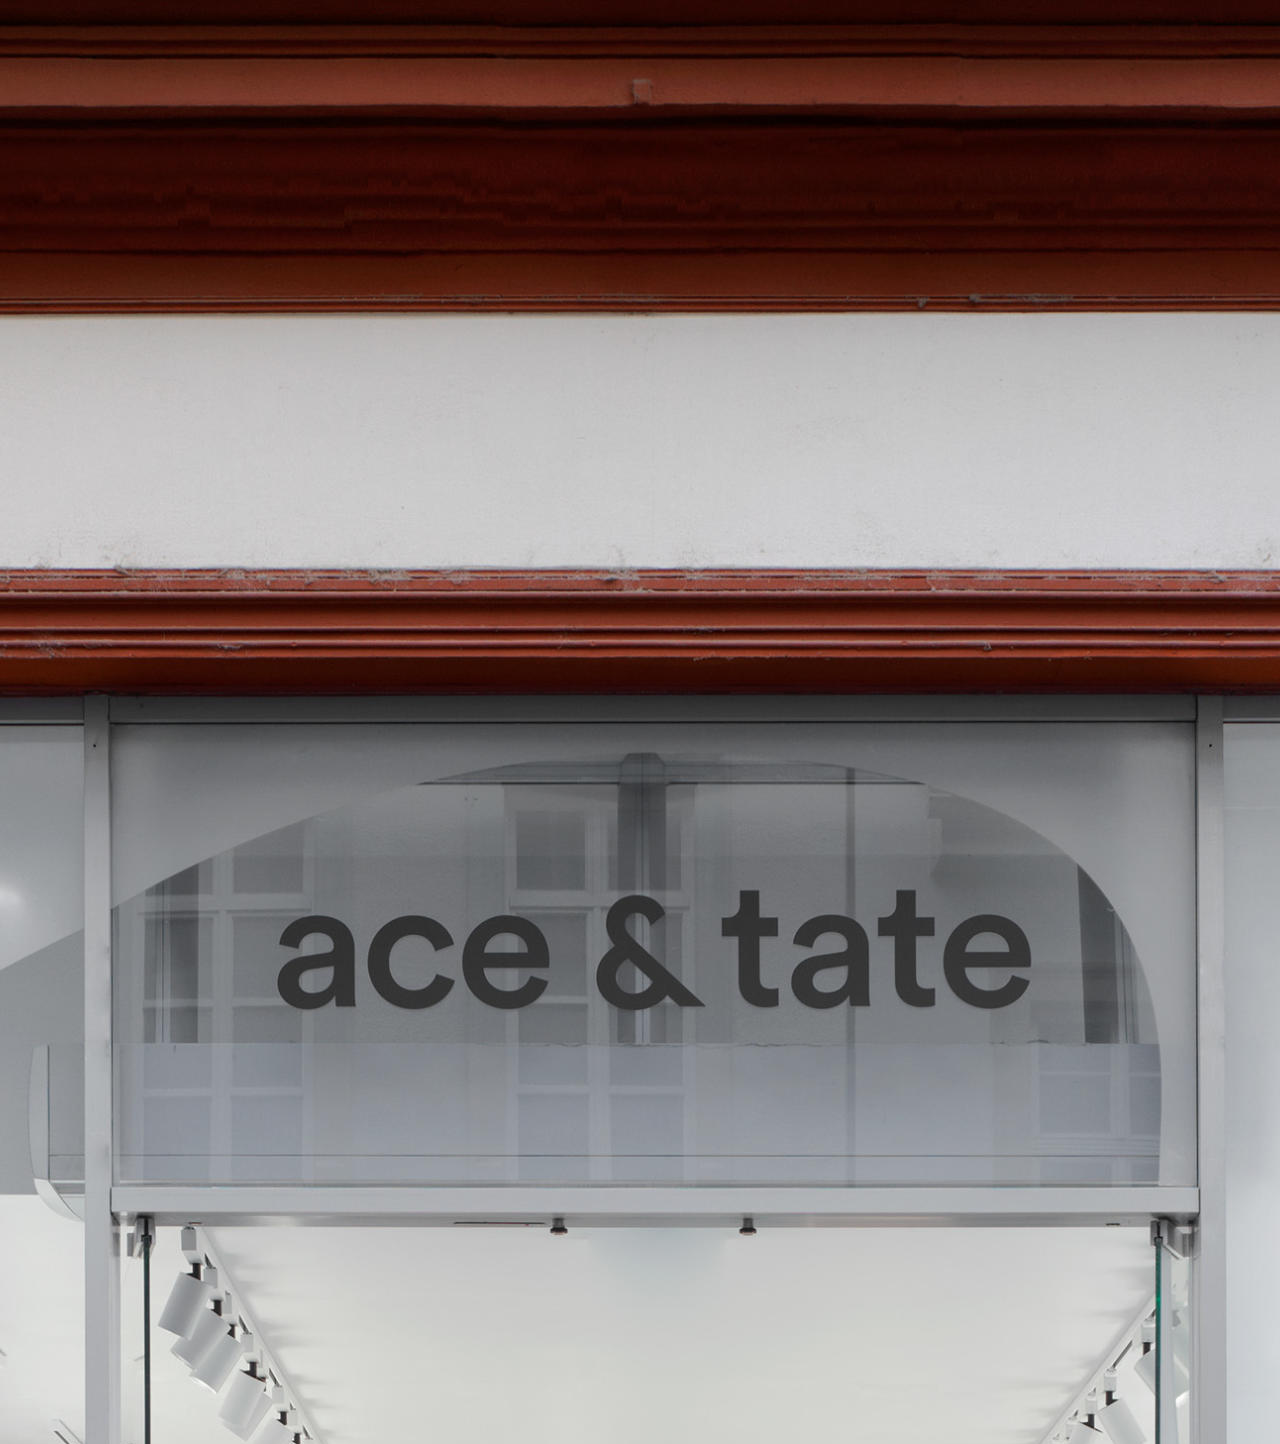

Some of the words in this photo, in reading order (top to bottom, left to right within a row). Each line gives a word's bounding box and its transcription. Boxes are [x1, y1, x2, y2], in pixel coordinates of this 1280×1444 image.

[277, 912, 551, 1010] ace
[595, 893, 706, 1010] &
[720, 888, 1033, 1010] tate
